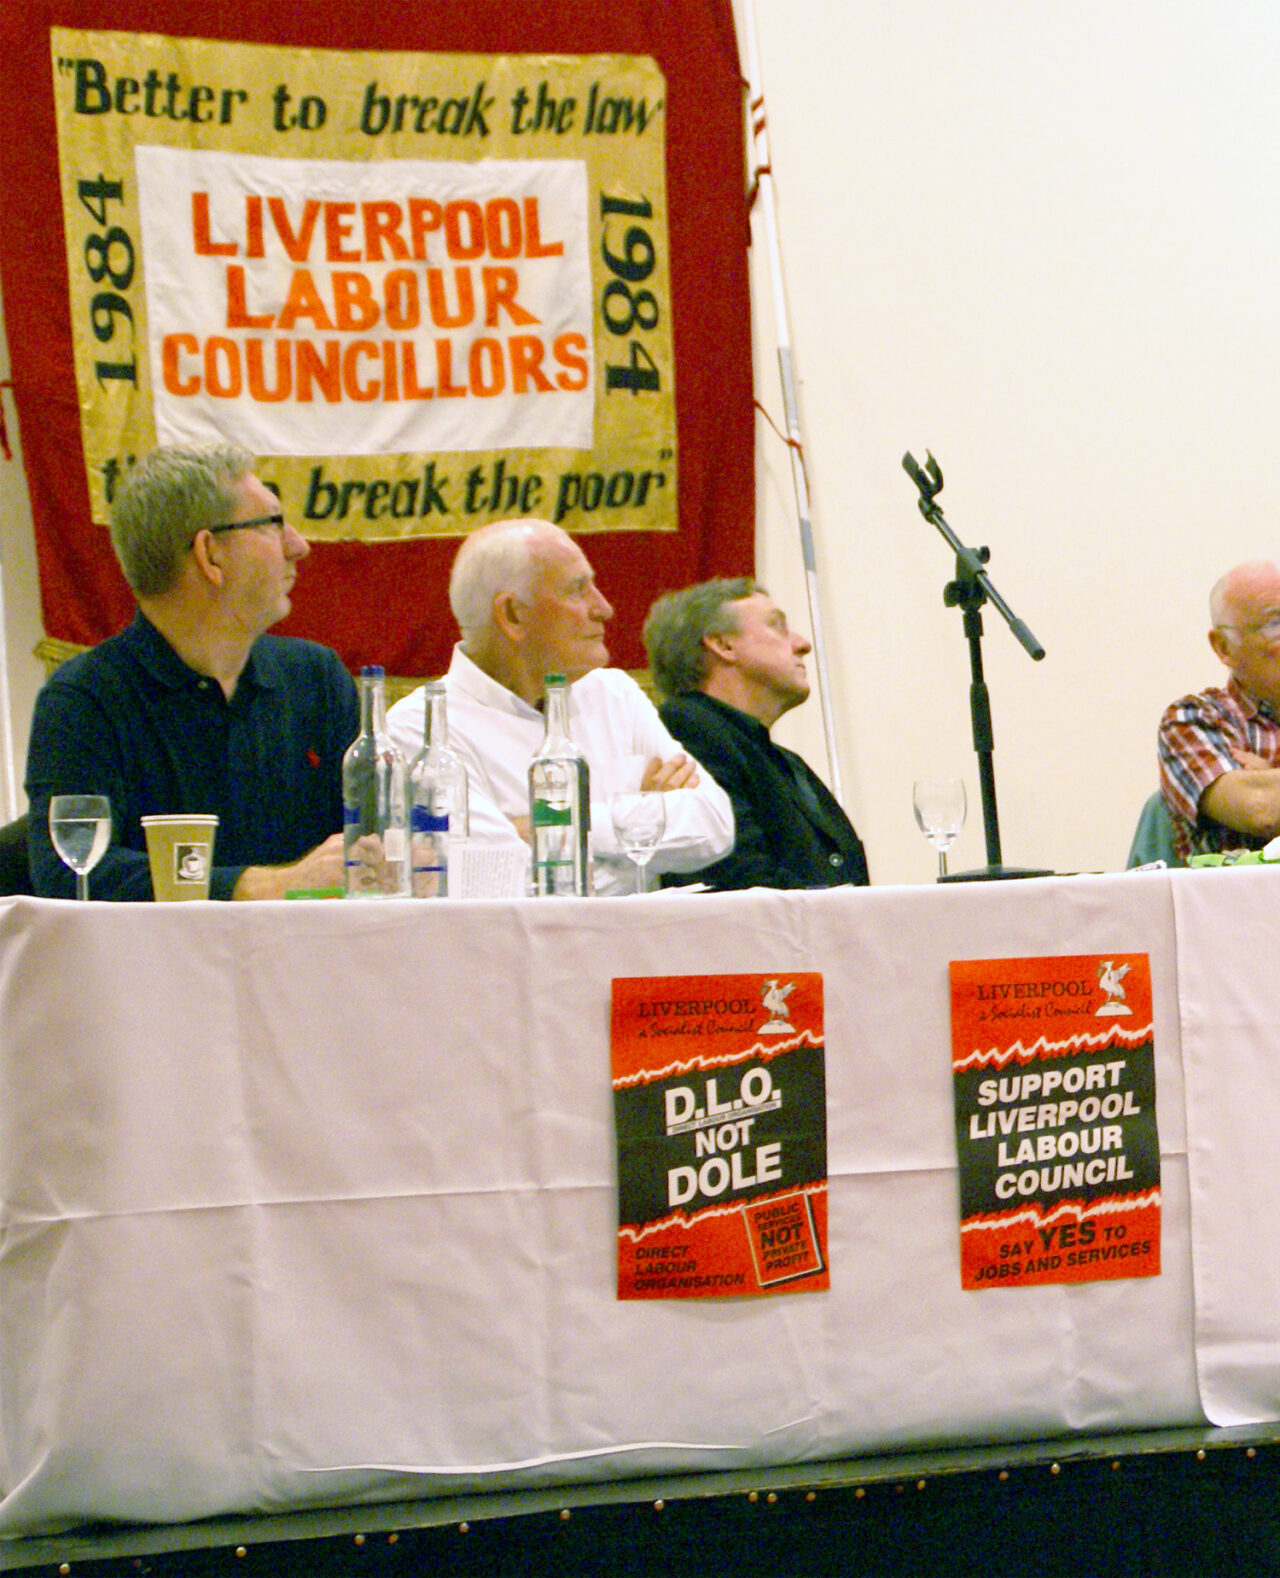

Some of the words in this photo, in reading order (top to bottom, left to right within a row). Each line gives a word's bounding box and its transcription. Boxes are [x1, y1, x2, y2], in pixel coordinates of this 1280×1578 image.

[272, 83, 327, 132] to
[360, 79, 495, 138] break
[510, 79, 576, 135] the
[583, 80, 664, 137] law
[191, 192, 564, 262] LIVERPOOL
[78, 172, 138, 392] 1984
[226, 265, 543, 332] LABOUR
[600, 190, 660, 396] 1984
[161, 332, 589, 403] COUNCILLORS
[304, 460, 448, 520] break
[464, 458, 542, 516] the
[638, 998, 756, 1018] LIVERPOOL
[977, 981, 1092, 1000] LIVERPOOL
[990, 1004, 1041, 1020] Socialist
[1044, 1001, 1092, 1017] Council
[705, 1018, 755, 1034] Council
[665, 1067, 781, 1126] D.L.O.
[977, 1061, 1126, 1106] SUPPORT
[969, 1091, 1140, 1140] LIVERPOOL
[695, 1118, 755, 1157] NOT
[998, 1124, 1123, 1167] LABOUR
[668, 1142, 782, 1207] DOLE
[995, 1155, 1133, 1199] COUNCIL
[635, 1245, 689, 1259] DIRECT
[761, 1221, 804, 1250] NOT
[1000, 1240, 1034, 1259] SAY
[1037, 1220, 1096, 1251] YES
[1104, 1225, 1126, 1241] TO
[634, 1273, 745, 1291] ORGANISATION
[635, 1261, 697, 1275] LABOUR
[974, 1261, 1021, 1282] JOBS
[1024, 1256, 1060, 1273] AND
[1066, 1240, 1151, 1267] SERVICES
